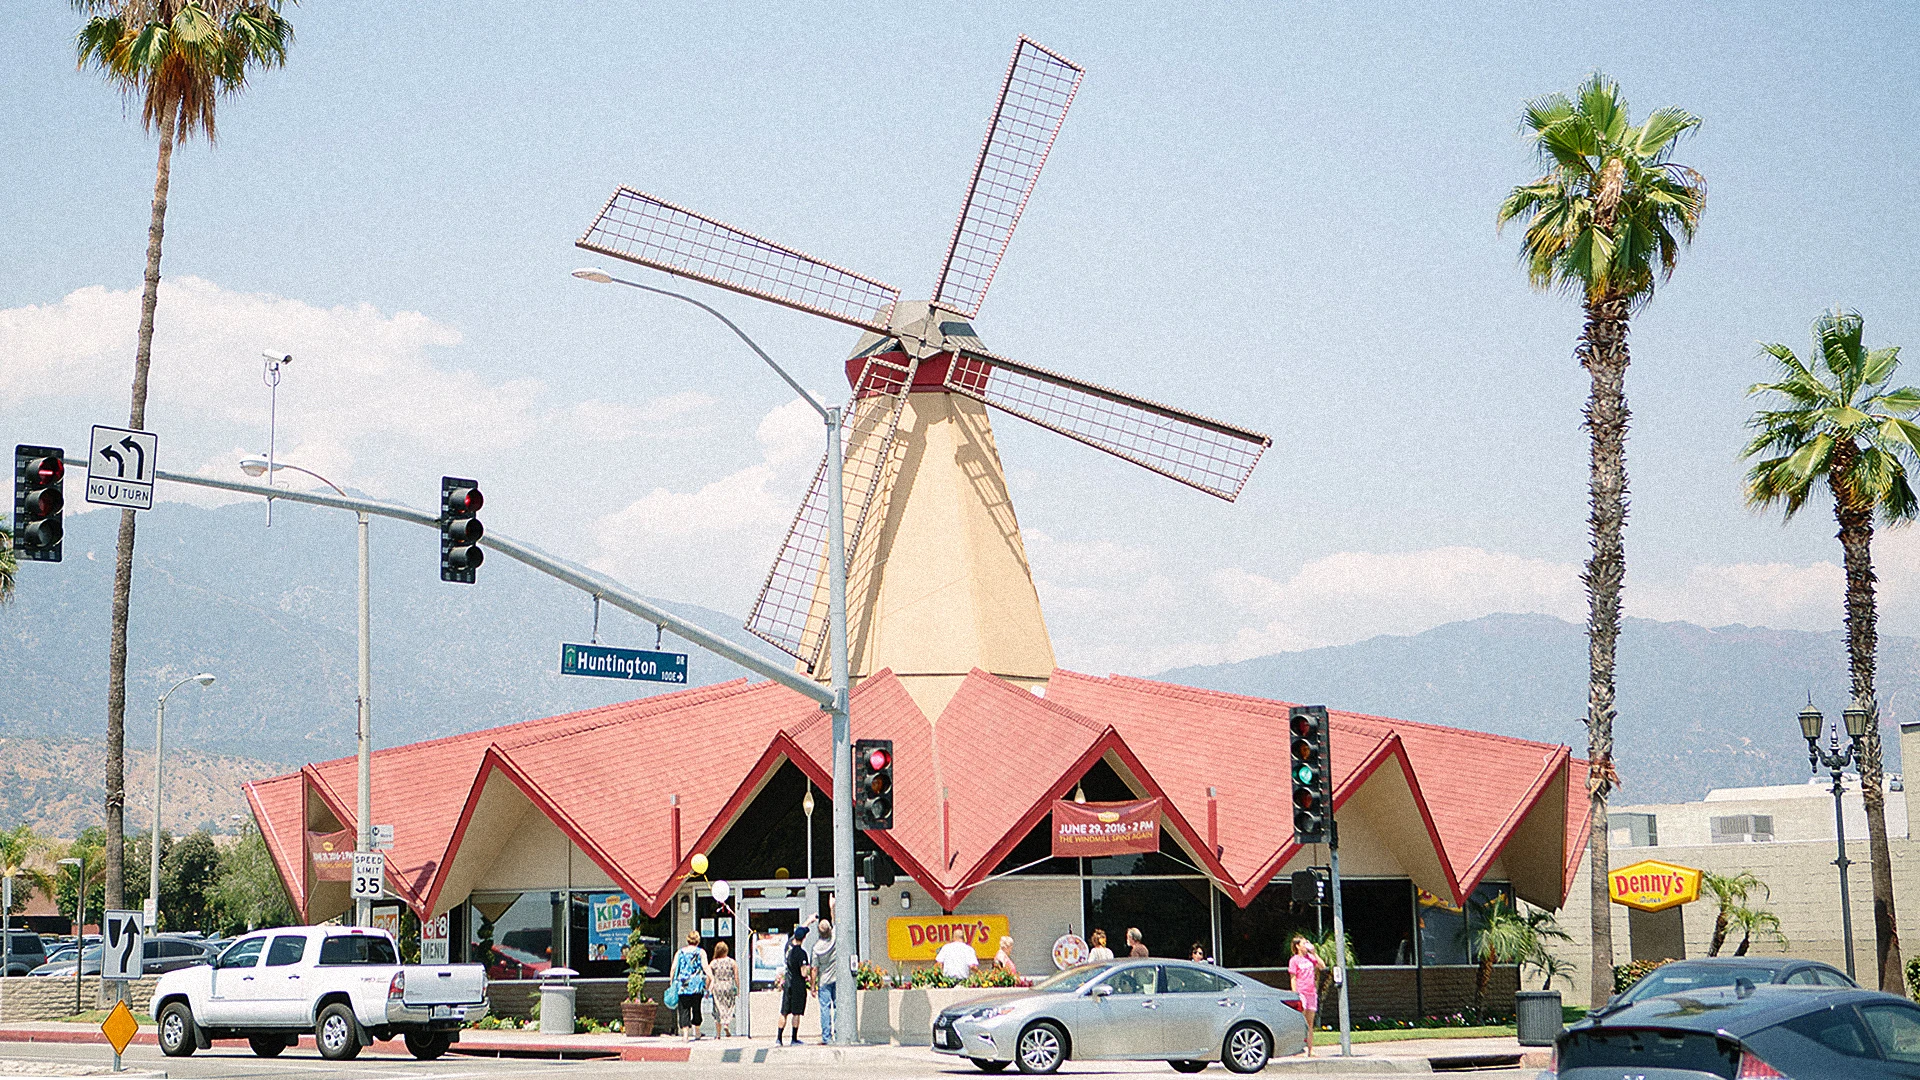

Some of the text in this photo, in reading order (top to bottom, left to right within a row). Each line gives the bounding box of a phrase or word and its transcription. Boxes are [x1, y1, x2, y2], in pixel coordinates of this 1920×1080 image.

[90, 484, 149, 501] NO U TURN
[577, 651, 657, 679] Huntington
[675, 655, 685, 665] DR
[1059, 820, 1154, 835] JUNE 29, 2016 2 PM
[1059, 835, 1073, 843] THE
[1075, 835, 1111, 843] WINDMILL
[1131, 831, 1153, 839] AGAIN
[355, 855, 383, 865] SPEED
[357, 866, 380, 875] LIMIT
[355, 877, 380, 894] 35
[1614, 871, 1684, 896] Denny's
[596, 902, 632, 922] KIDS
[597, 921, 611, 930] EAT
[721, 920, 730, 930] A
[422, 942, 447, 959] MENU
